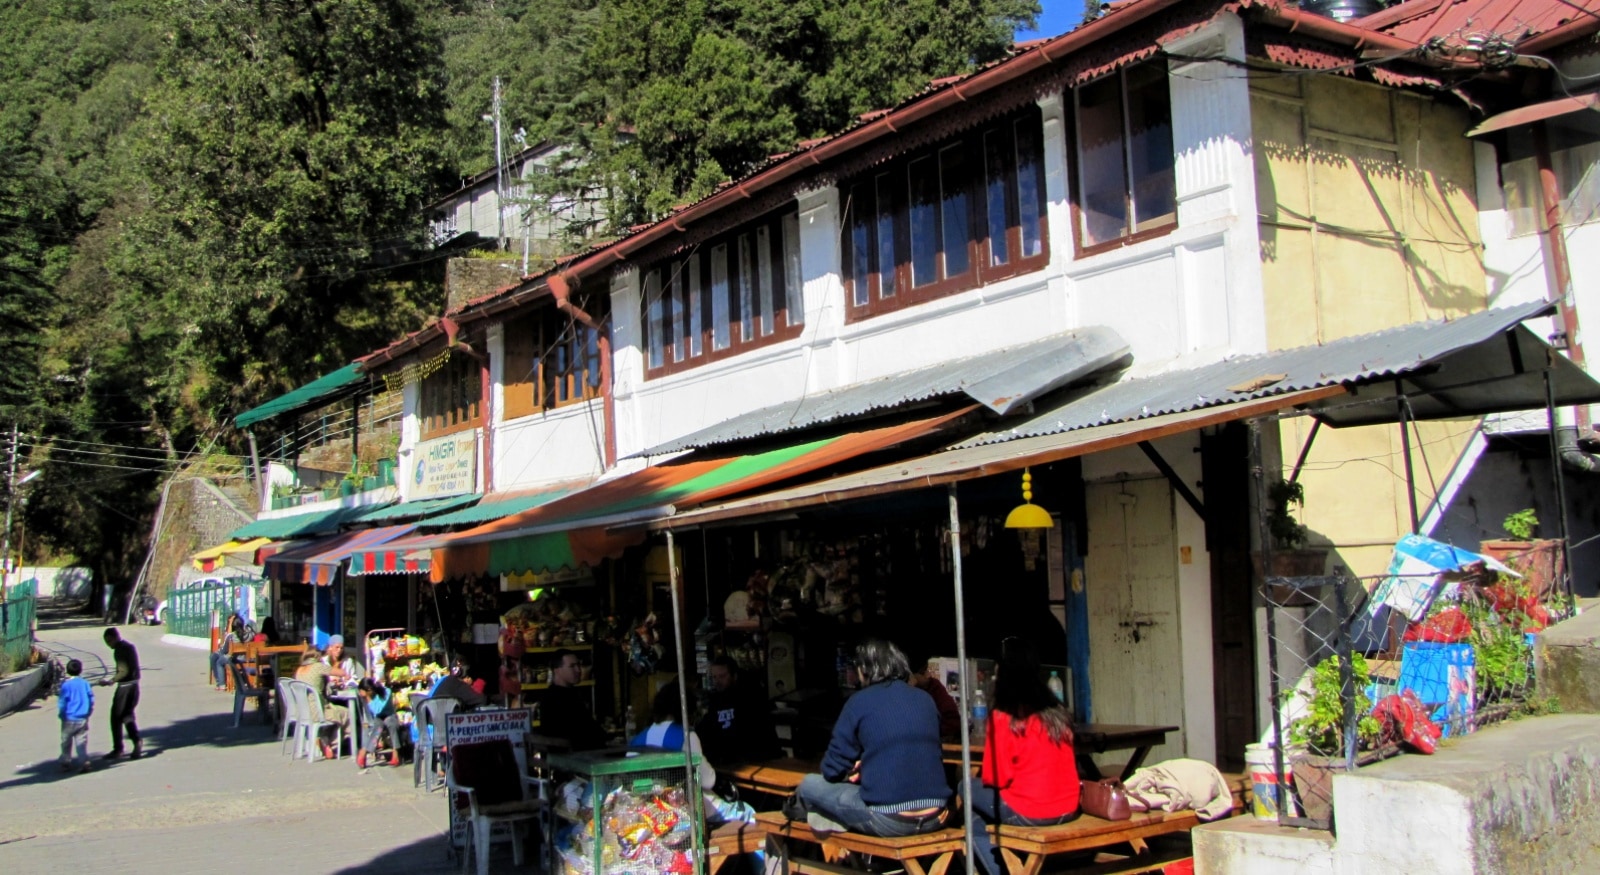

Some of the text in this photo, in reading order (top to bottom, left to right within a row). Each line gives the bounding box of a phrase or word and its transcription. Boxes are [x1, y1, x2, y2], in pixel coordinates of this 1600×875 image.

[467, 715, 486, 723] TOP
[488, 713, 505, 721] TEA
[506, 712, 528, 720] SHOP
[457, 725, 486, 736] PERFECT
[510, 721, 526, 731] BAR
